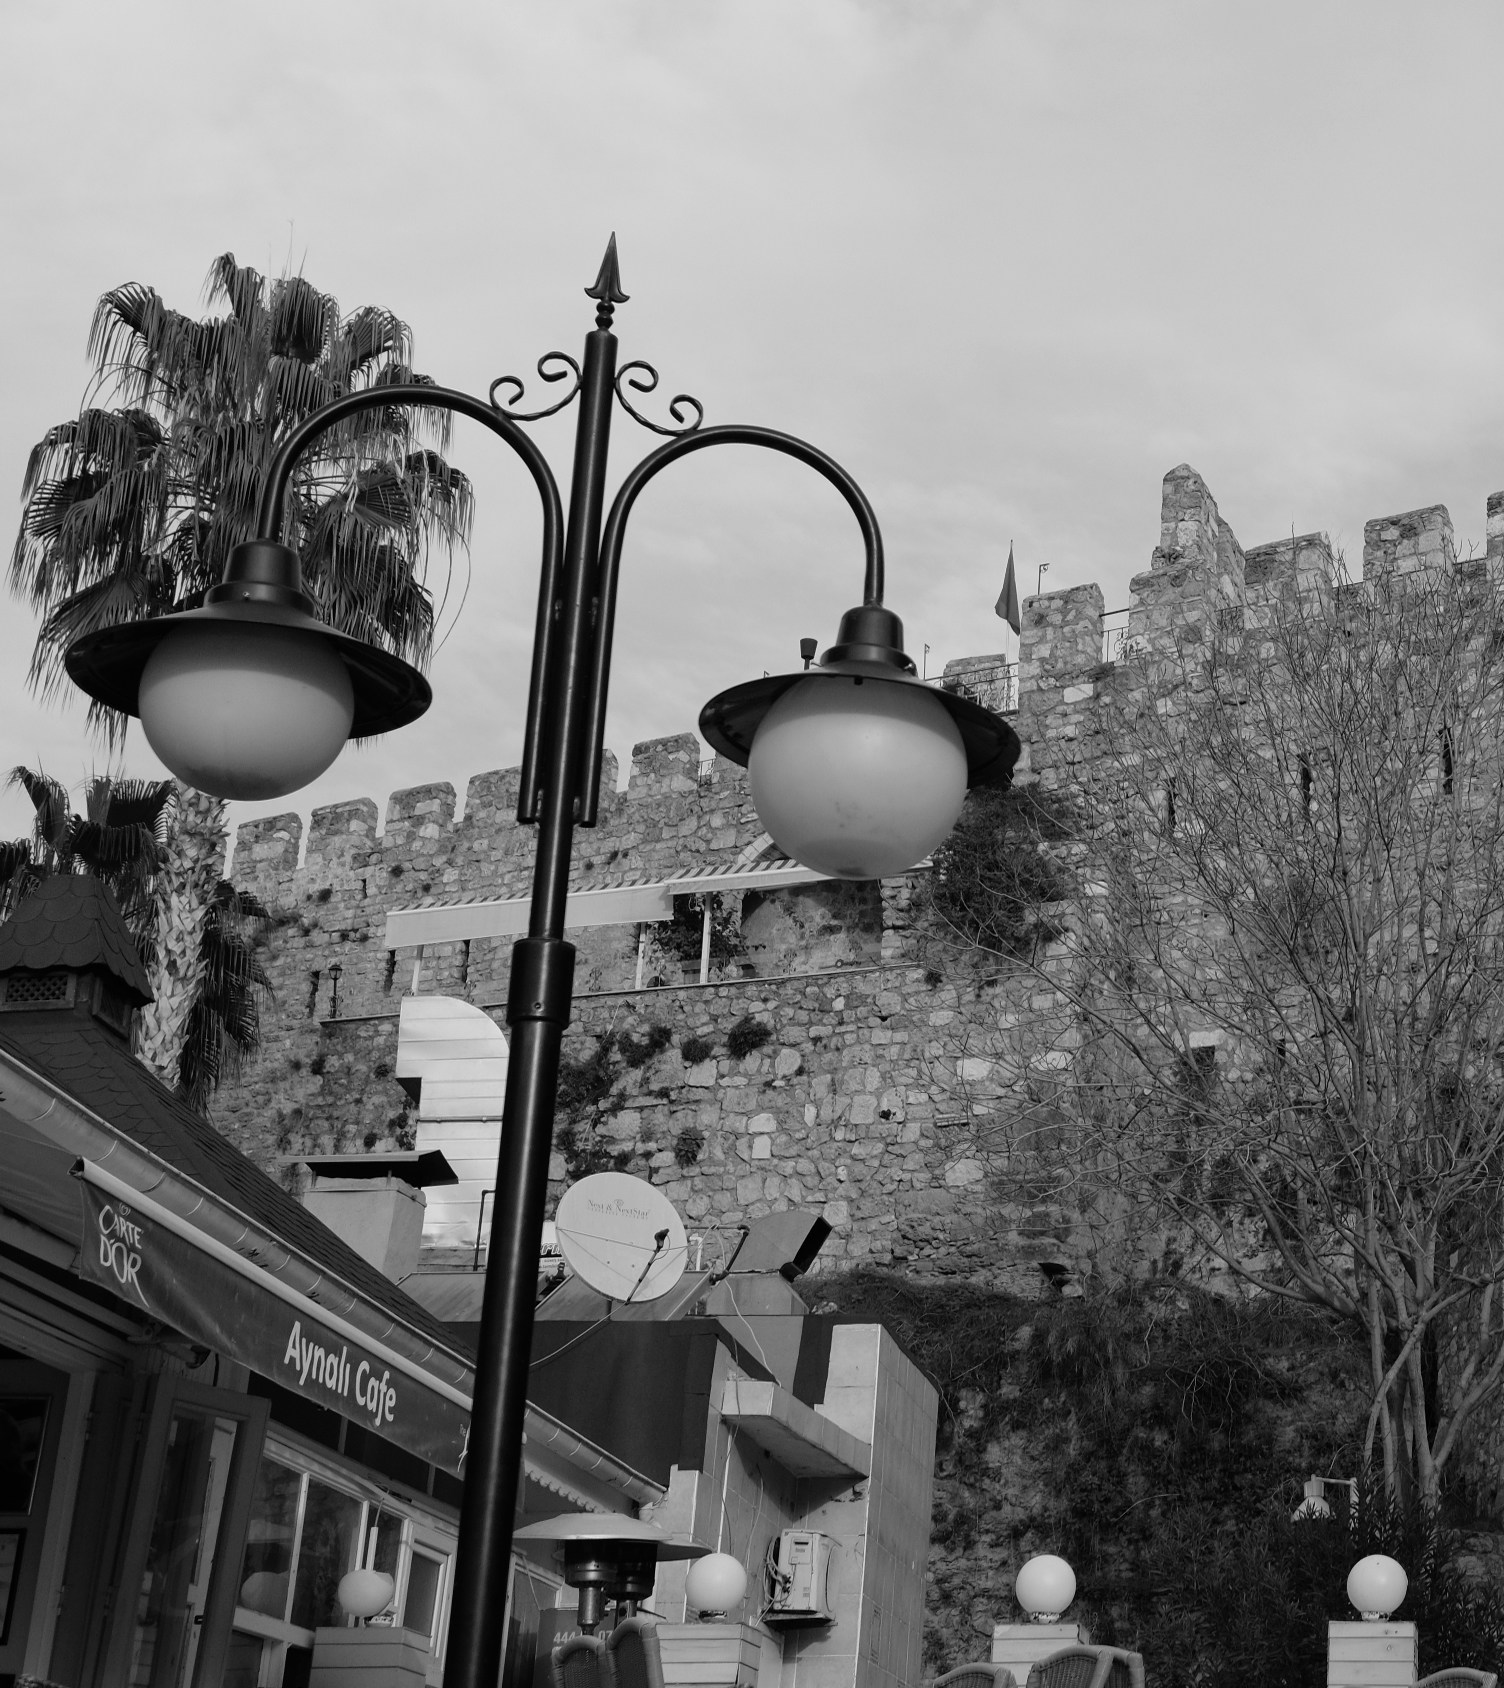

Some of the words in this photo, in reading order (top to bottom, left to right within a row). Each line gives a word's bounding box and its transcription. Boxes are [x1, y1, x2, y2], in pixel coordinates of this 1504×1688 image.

[99, 1204, 144, 1250] CARTE
[284, 1320, 351, 1398] Aynalı
[355, 1360, 397, 1427] Cafe
